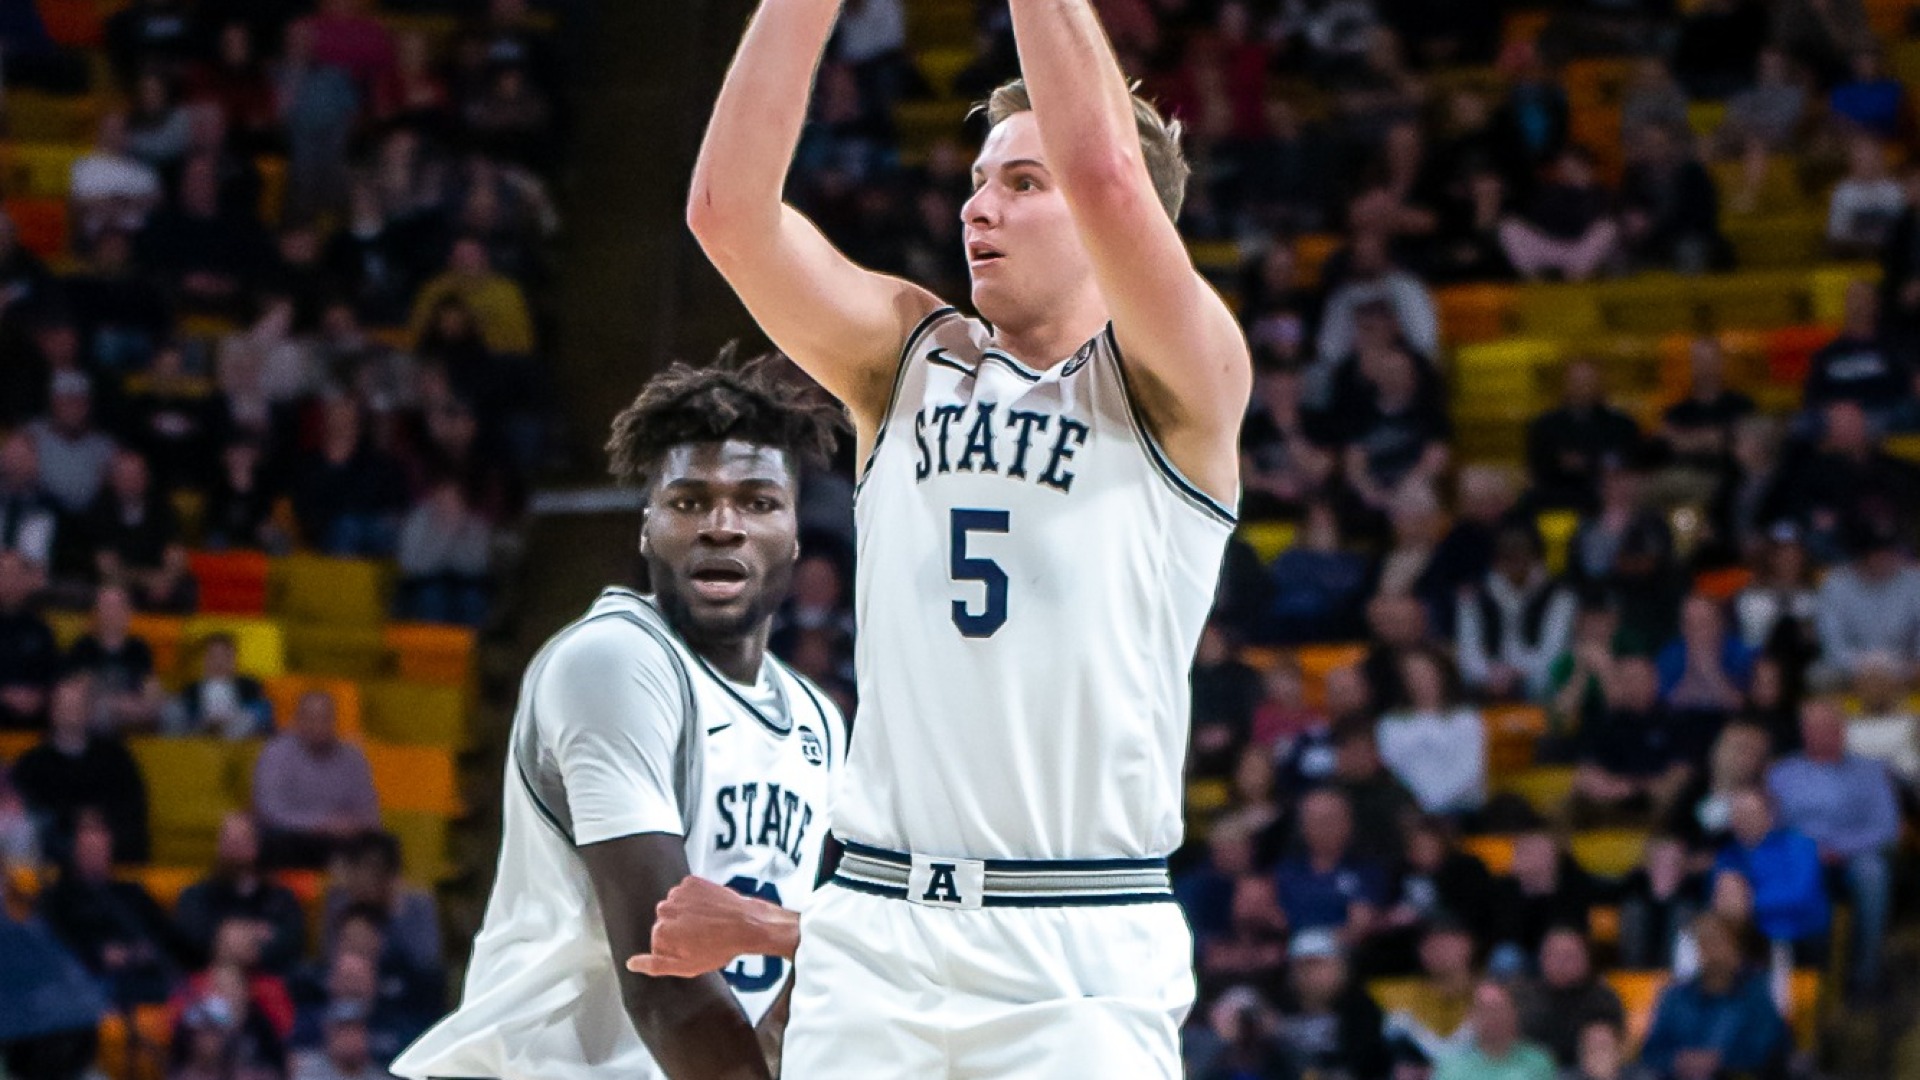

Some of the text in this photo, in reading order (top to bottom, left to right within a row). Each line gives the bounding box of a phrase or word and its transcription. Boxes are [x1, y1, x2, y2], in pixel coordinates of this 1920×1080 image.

[915, 402, 1090, 495] STATE
[950, 508, 1010, 638] 5
[714, 782, 813, 868] STATE
[922, 863, 962, 904] A
